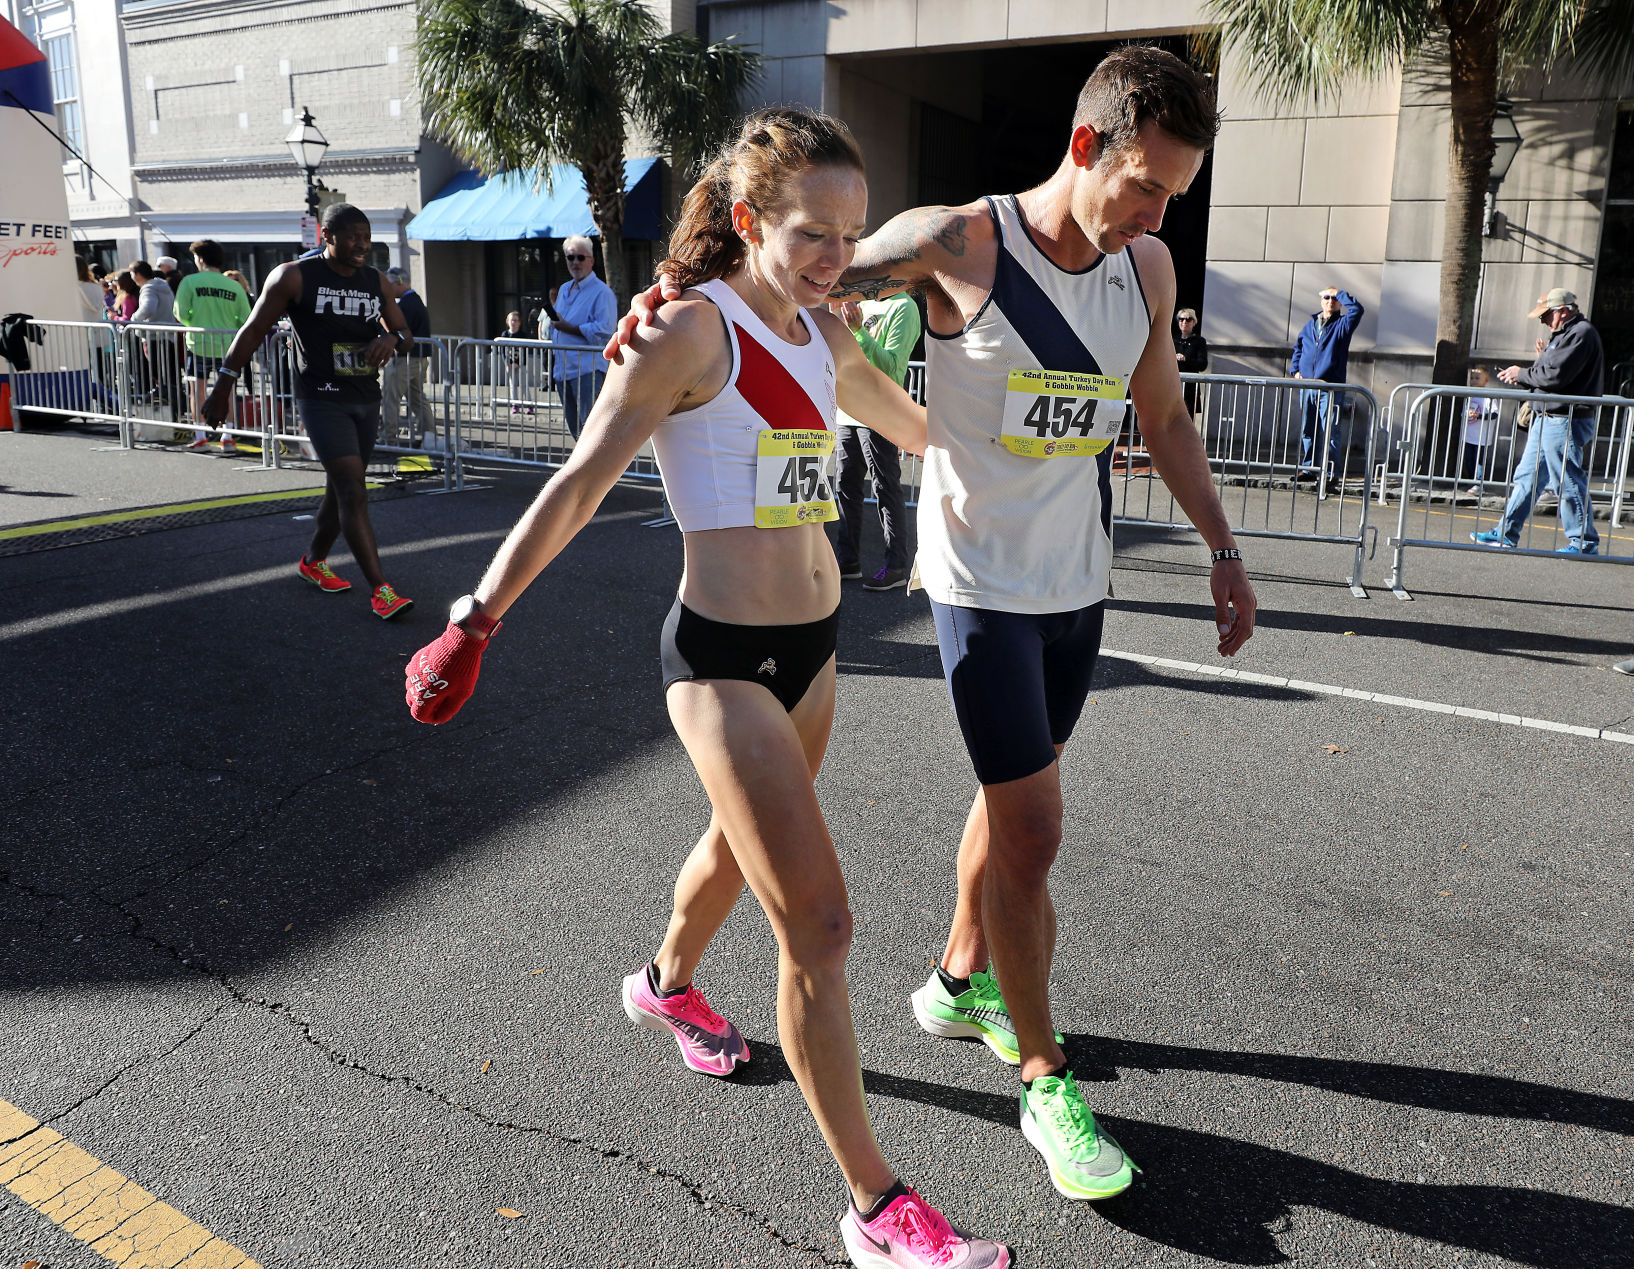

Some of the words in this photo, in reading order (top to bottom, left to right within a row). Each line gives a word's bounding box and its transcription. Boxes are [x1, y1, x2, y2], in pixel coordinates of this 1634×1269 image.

[31, 223, 68, 239] FEET
[195, 286, 237, 302] VOLUNTEER
[314, 294, 372, 317] run
[1021, 371, 1042, 379] 42nd
[1043, 373, 1067, 381] Annual
[1068, 374, 1091, 384] Turkey
[1092, 376, 1104, 386] Day
[1105, 378, 1116, 386] Run
[1052, 382, 1075, 390] Gobble
[1076, 384, 1099, 392] Wobble
[1023, 395, 1098, 438] 454
[771, 432, 789, 440] 42nd
[791, 431, 809, 440] Annual
[796, 441, 816, 449] Gobble
[409, 673, 438, 700] ARE
